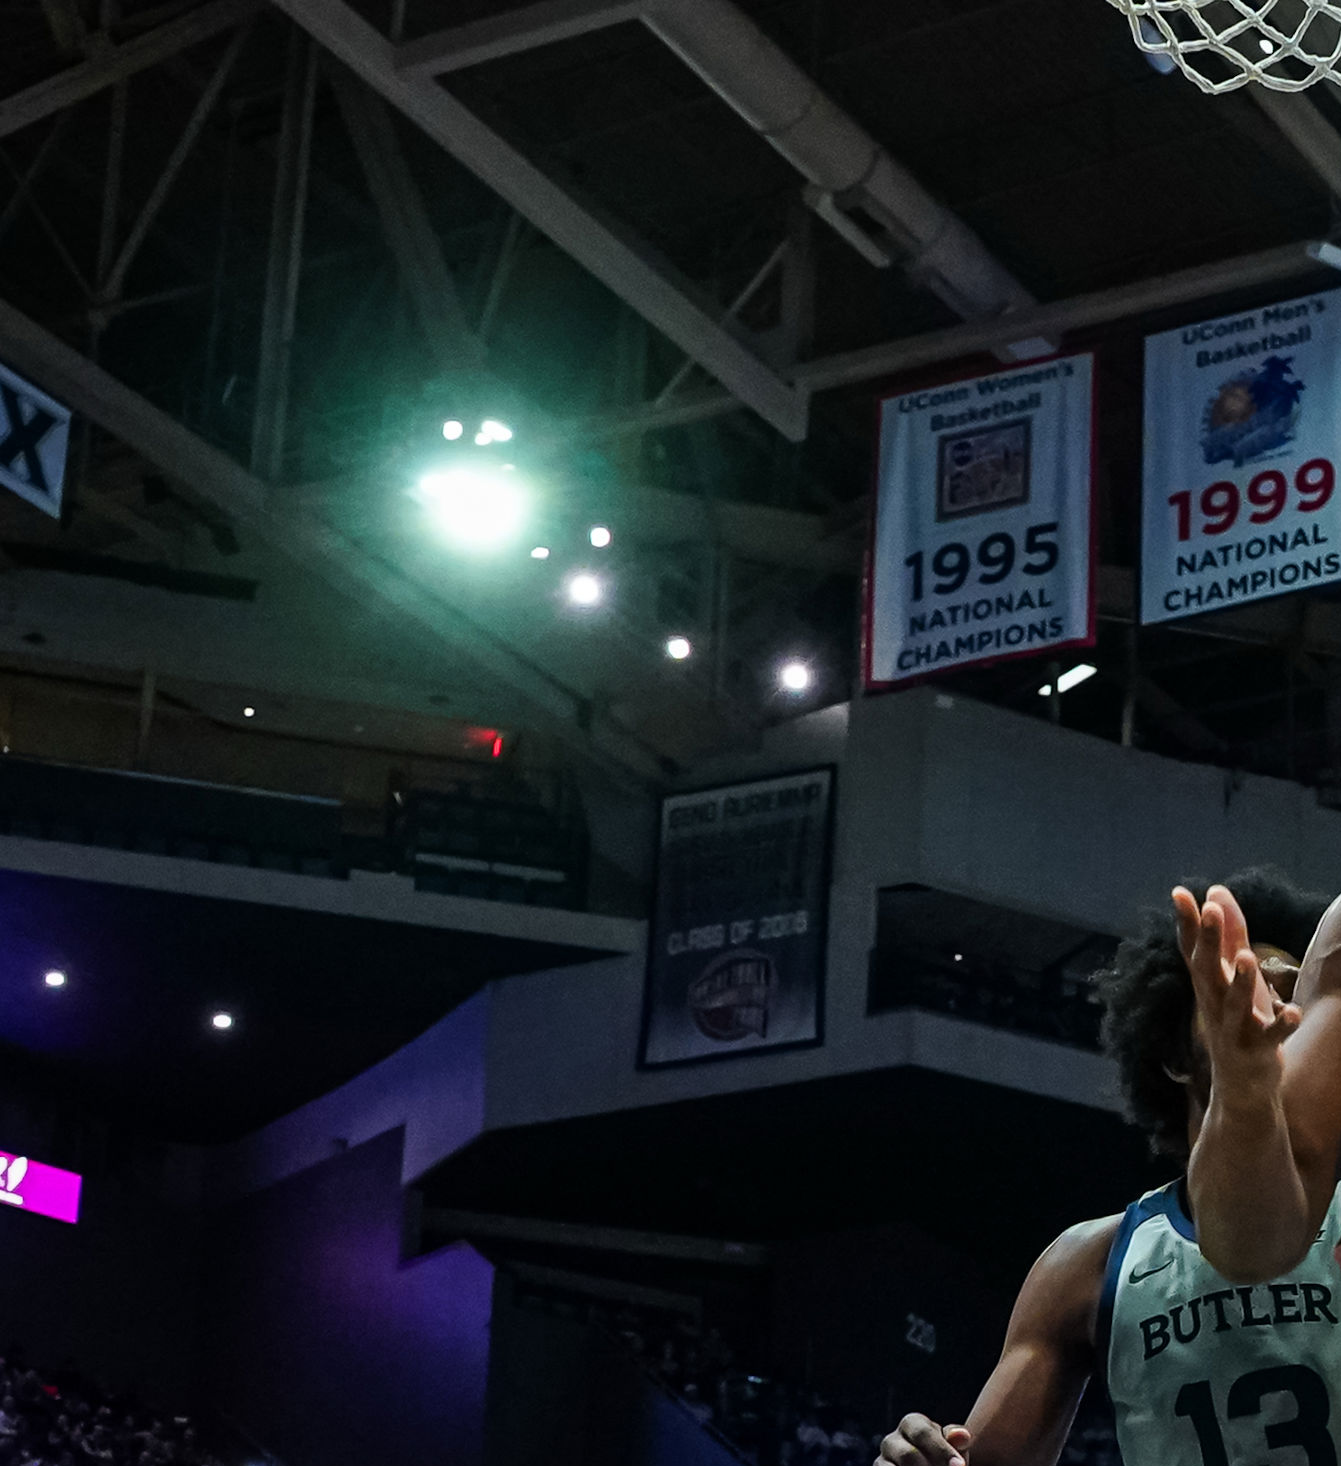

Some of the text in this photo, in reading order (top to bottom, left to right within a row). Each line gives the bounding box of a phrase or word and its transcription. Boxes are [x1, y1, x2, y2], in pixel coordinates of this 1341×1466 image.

[1196, 325, 1311, 368] Basketball
[1168, 458, 1335, 541] 1999
[905, 522, 1059, 602] 1995
[1176, 523, 1328, 576] NATIONAL
[1163, 553, 1340, 611] CHAMPIONS
[909, 588, 1054, 637] NATIONAL
[897, 617, 1063, 670] CHAMPIONS
[1139, 1283, 1339, 1361] BUTLER
